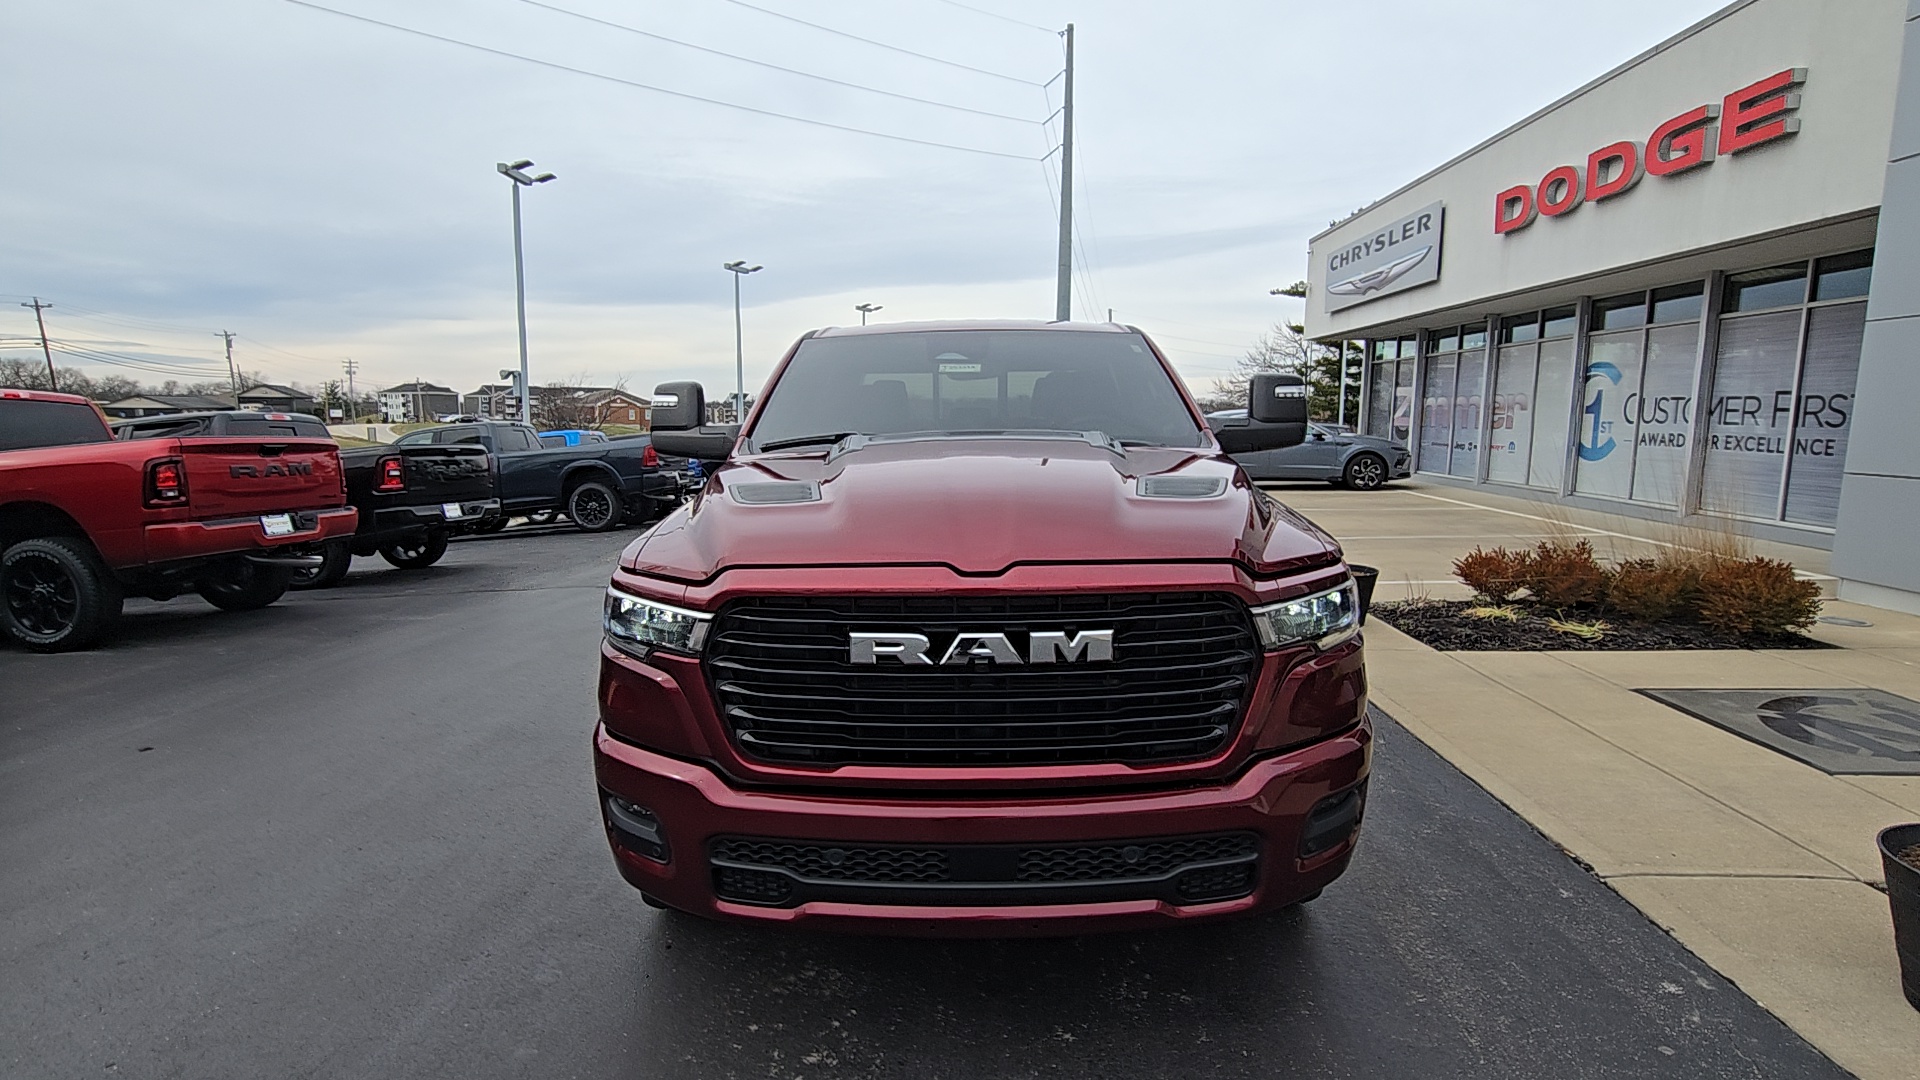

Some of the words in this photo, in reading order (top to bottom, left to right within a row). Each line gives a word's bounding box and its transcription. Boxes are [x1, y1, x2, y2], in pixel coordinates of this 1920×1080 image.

[1494, 68, 1807, 234] DODGE
[1329, 213, 1432, 271] CHRYSLER
[1393, 386, 1528, 430] Zmmer
[1770, 390, 1857, 429] FIRS
[1639, 433, 1686, 448] AWARD
[1723, 435, 1837, 457] EXCELLNCE
[229, 462, 313, 479] RAM
[849, 629, 1114, 665] RAM
